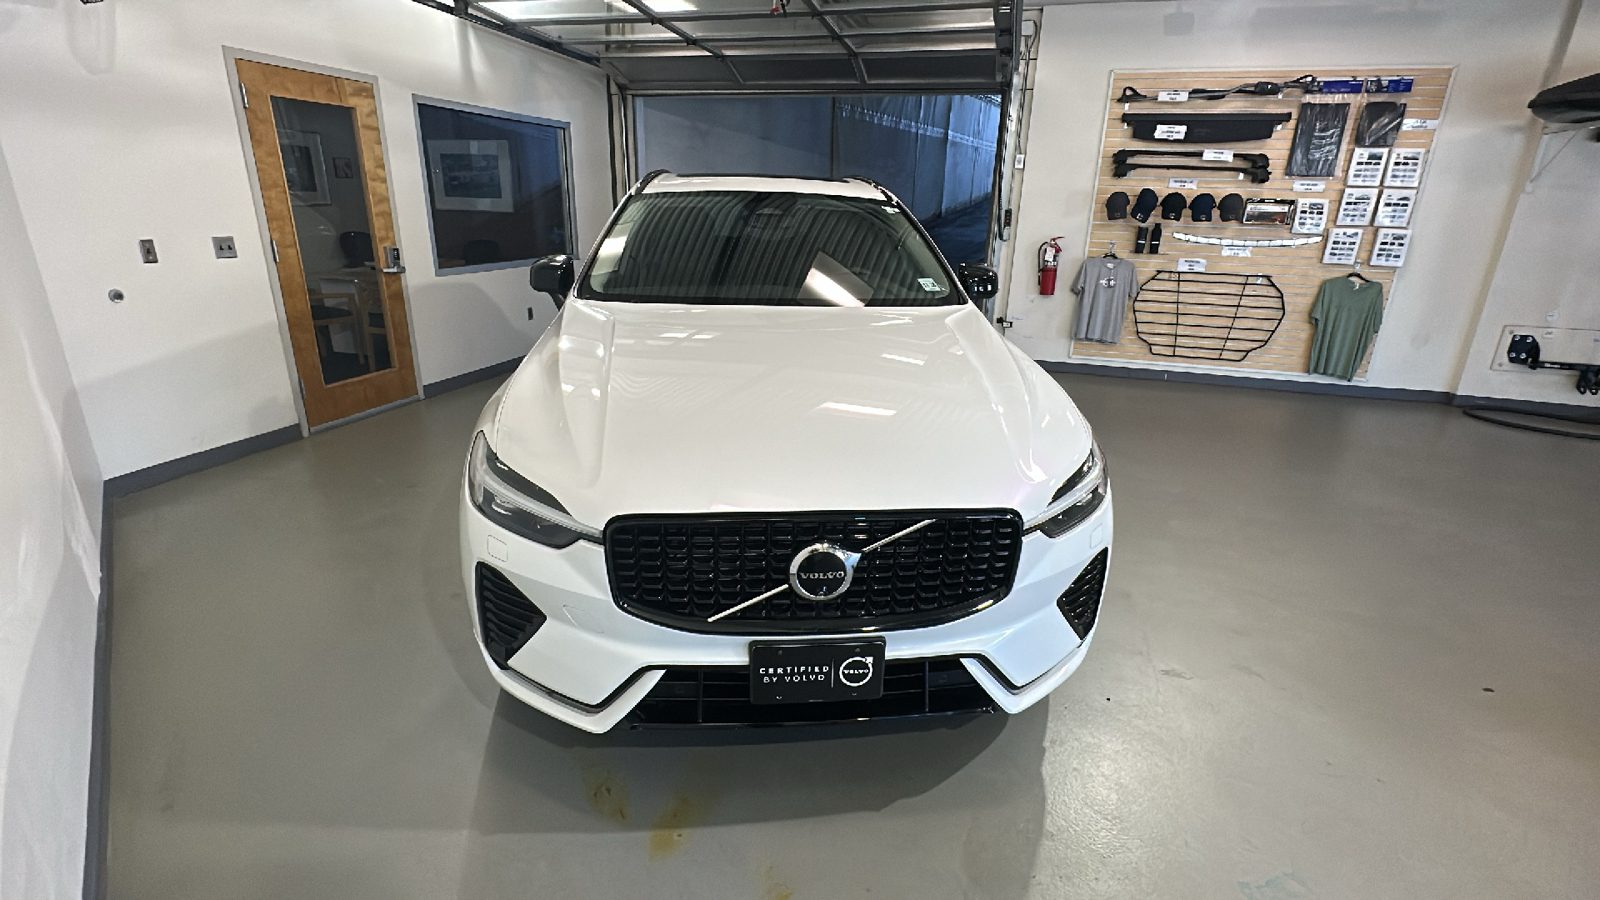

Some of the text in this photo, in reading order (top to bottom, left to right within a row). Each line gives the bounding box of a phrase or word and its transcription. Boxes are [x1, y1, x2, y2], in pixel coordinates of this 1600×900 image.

[800, 571, 844, 579] VOLVO
[759, 666, 829, 674] CERTIFIED
[784, 674, 825, 683] VOLVO
